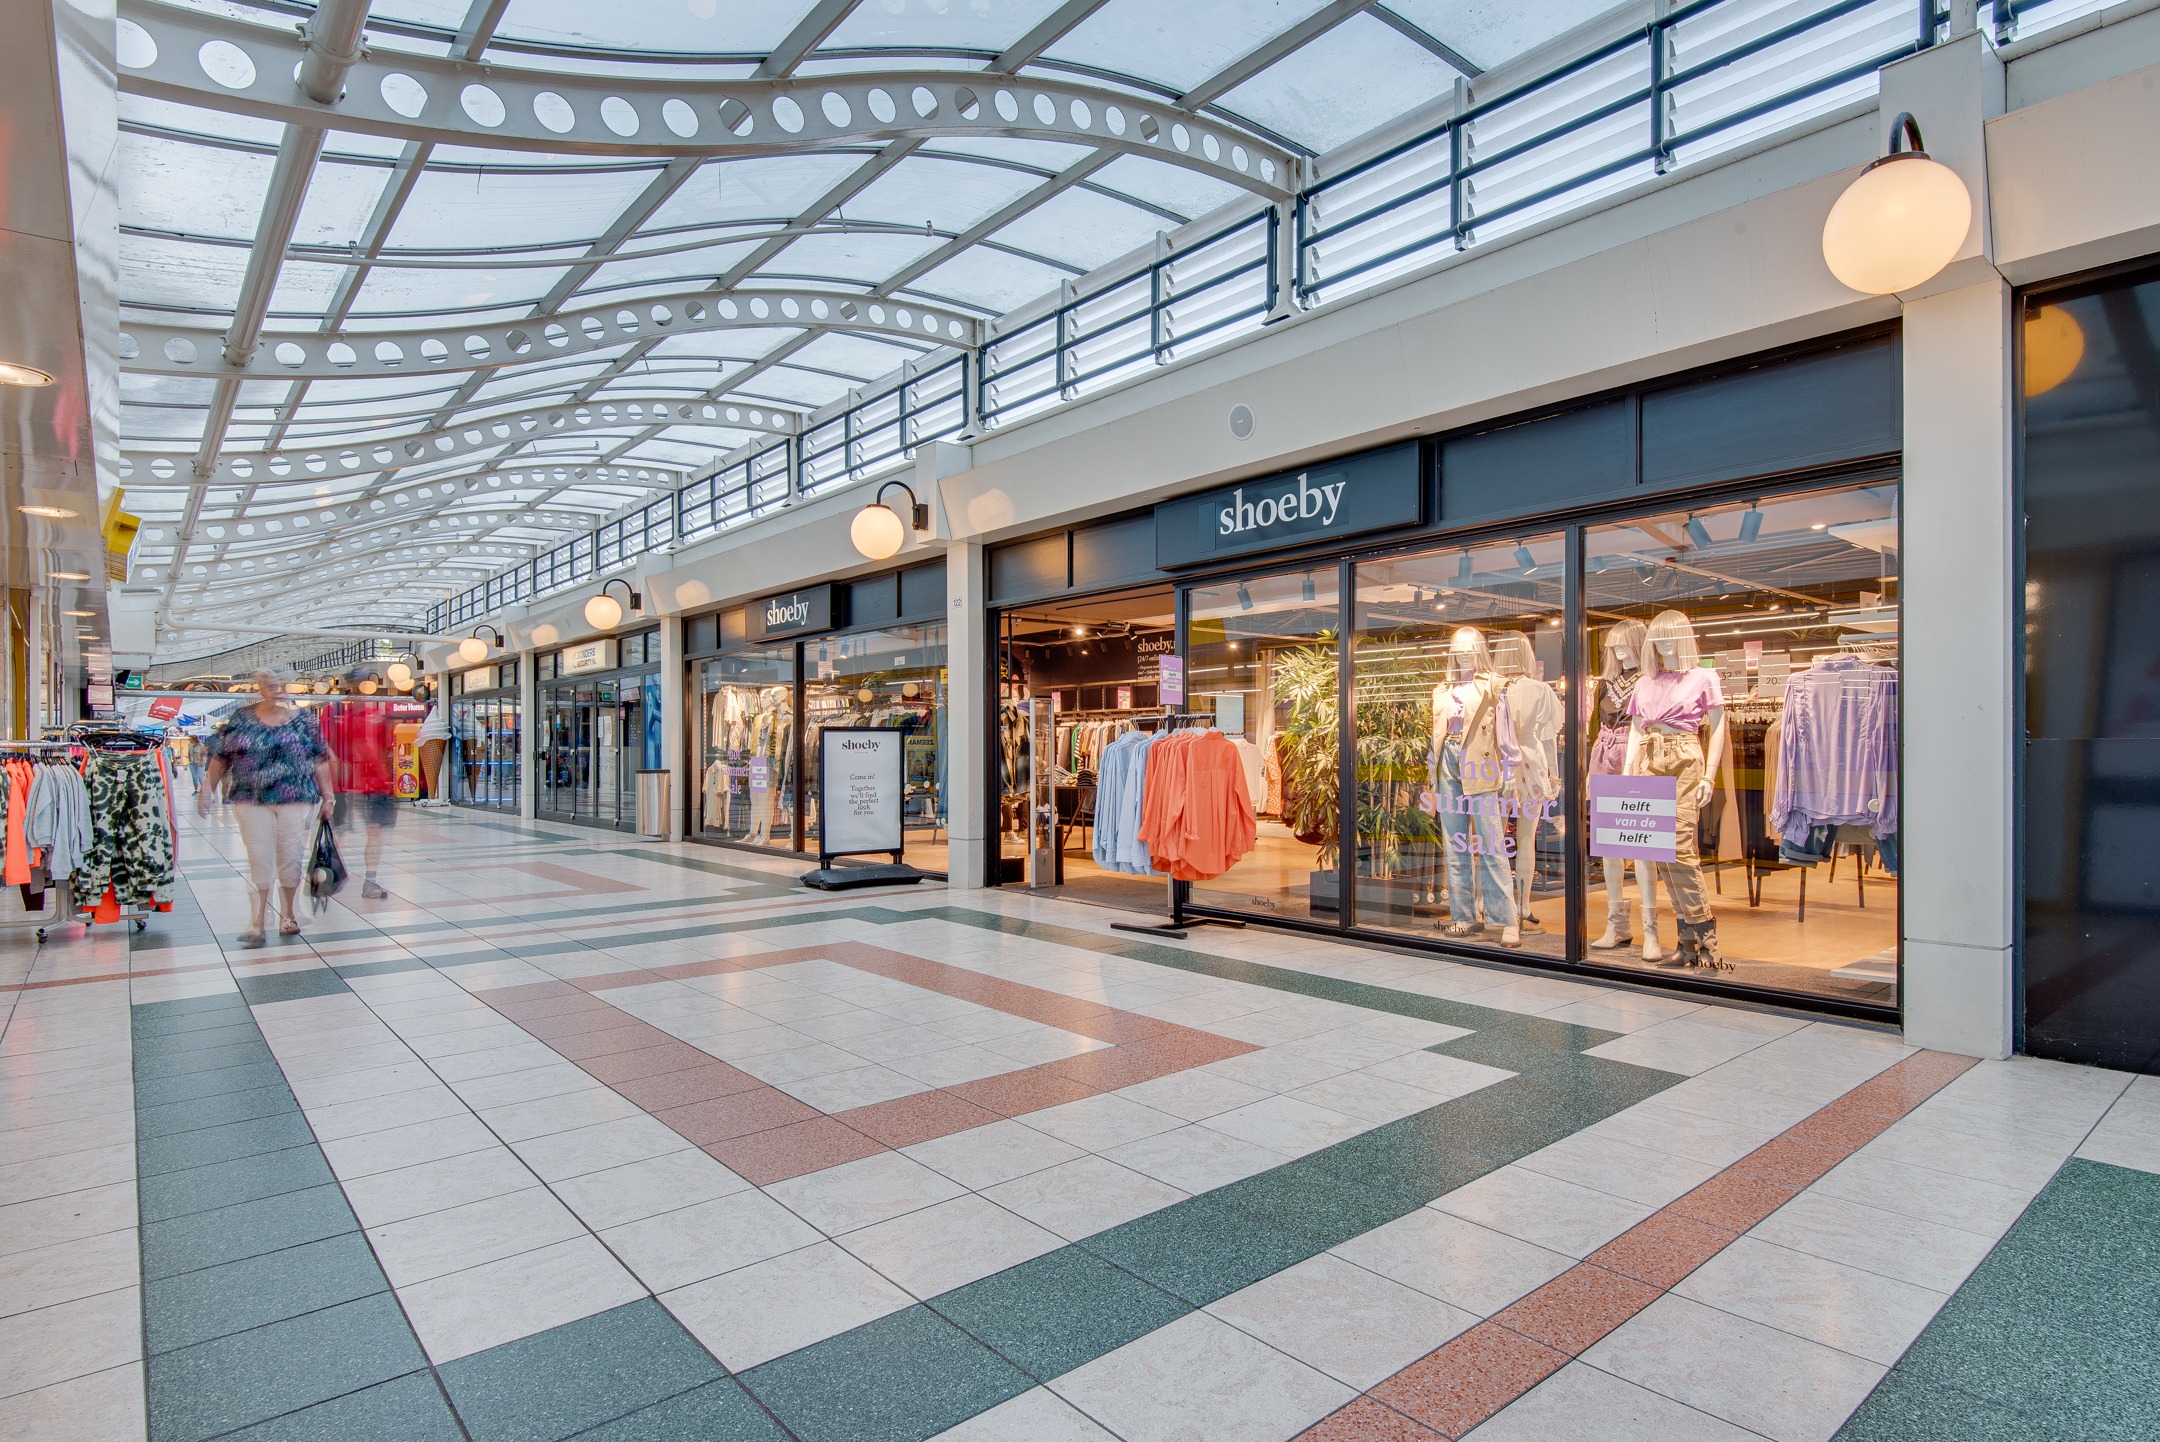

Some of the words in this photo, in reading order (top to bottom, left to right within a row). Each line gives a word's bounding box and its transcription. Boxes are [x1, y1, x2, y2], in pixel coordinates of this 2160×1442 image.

[1220, 472, 1346, 535] shoeby
[767, 594, 809, 626] shoeby
[1137, 636, 1175, 653] shoeby.
[841, 739, 880, 752] shoeby
[1457, 748, 1516, 782] hot
[850, 785, 876, 793] Together
[1419, 791, 1558, 820] summer
[1620, 800, 1651, 812] helft
[1615, 818, 1637, 827] van
[1640, 817, 1657, 828] de
[1452, 824, 1518, 859] sale
[1251, 896, 1276, 911] shoeby
[1689, 955, 1736, 975] shoeby
